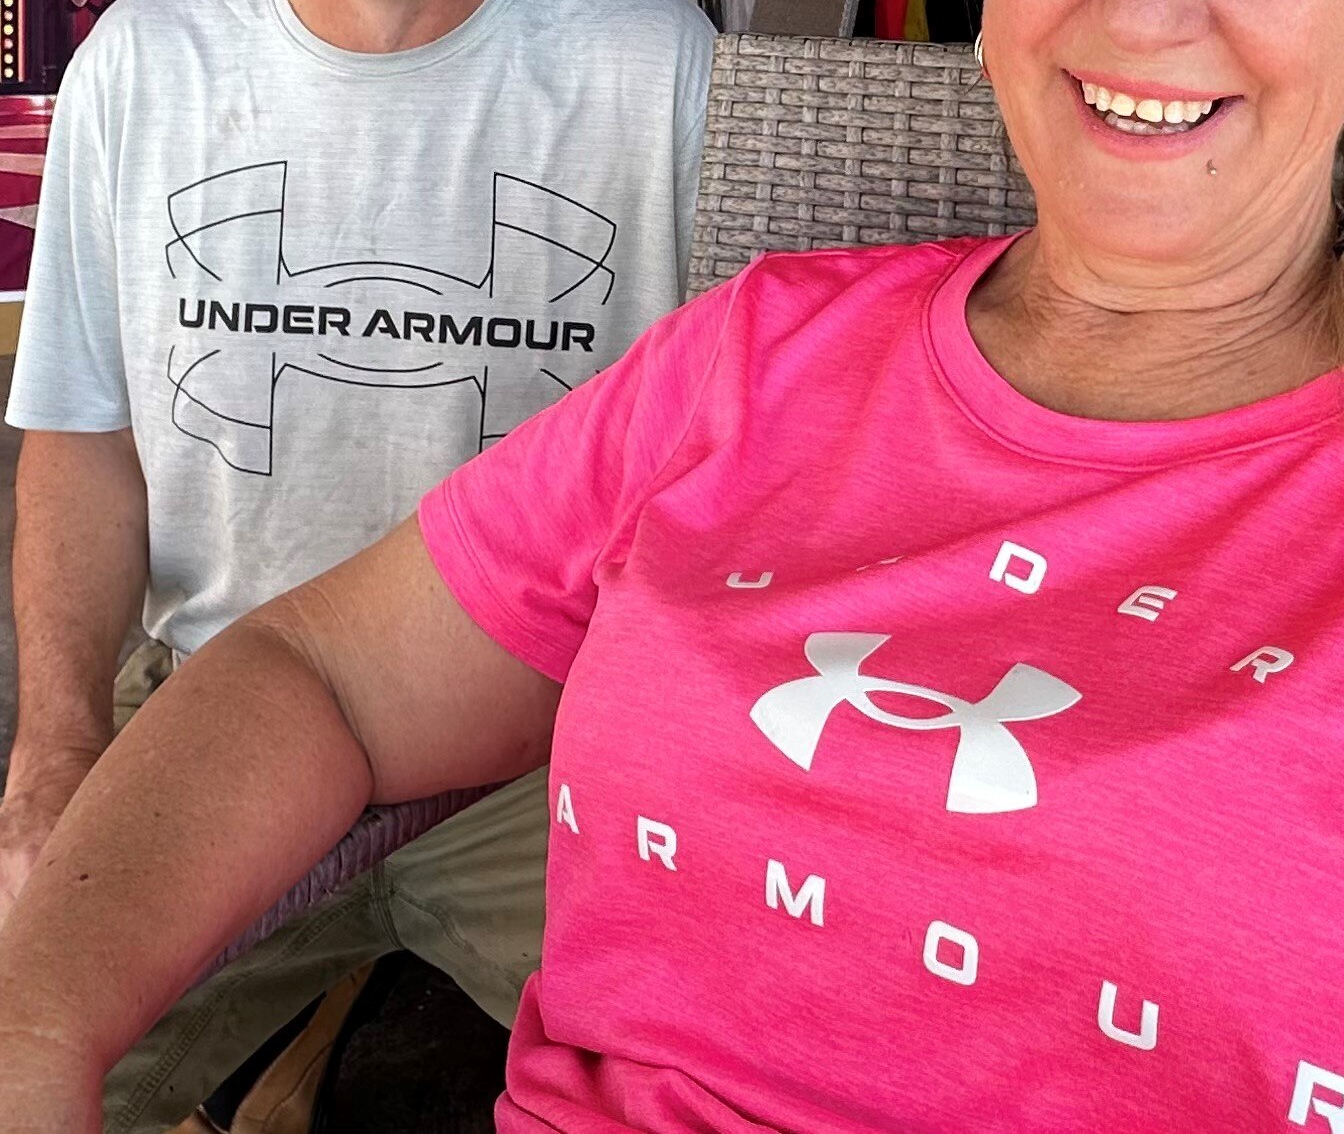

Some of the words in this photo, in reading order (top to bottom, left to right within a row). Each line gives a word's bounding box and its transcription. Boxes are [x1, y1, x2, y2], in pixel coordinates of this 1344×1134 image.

[178, 297, 353, 337] UNDER
[362, 308, 597, 353] ARMOUR
[725, 540, 1295, 685] UDER
